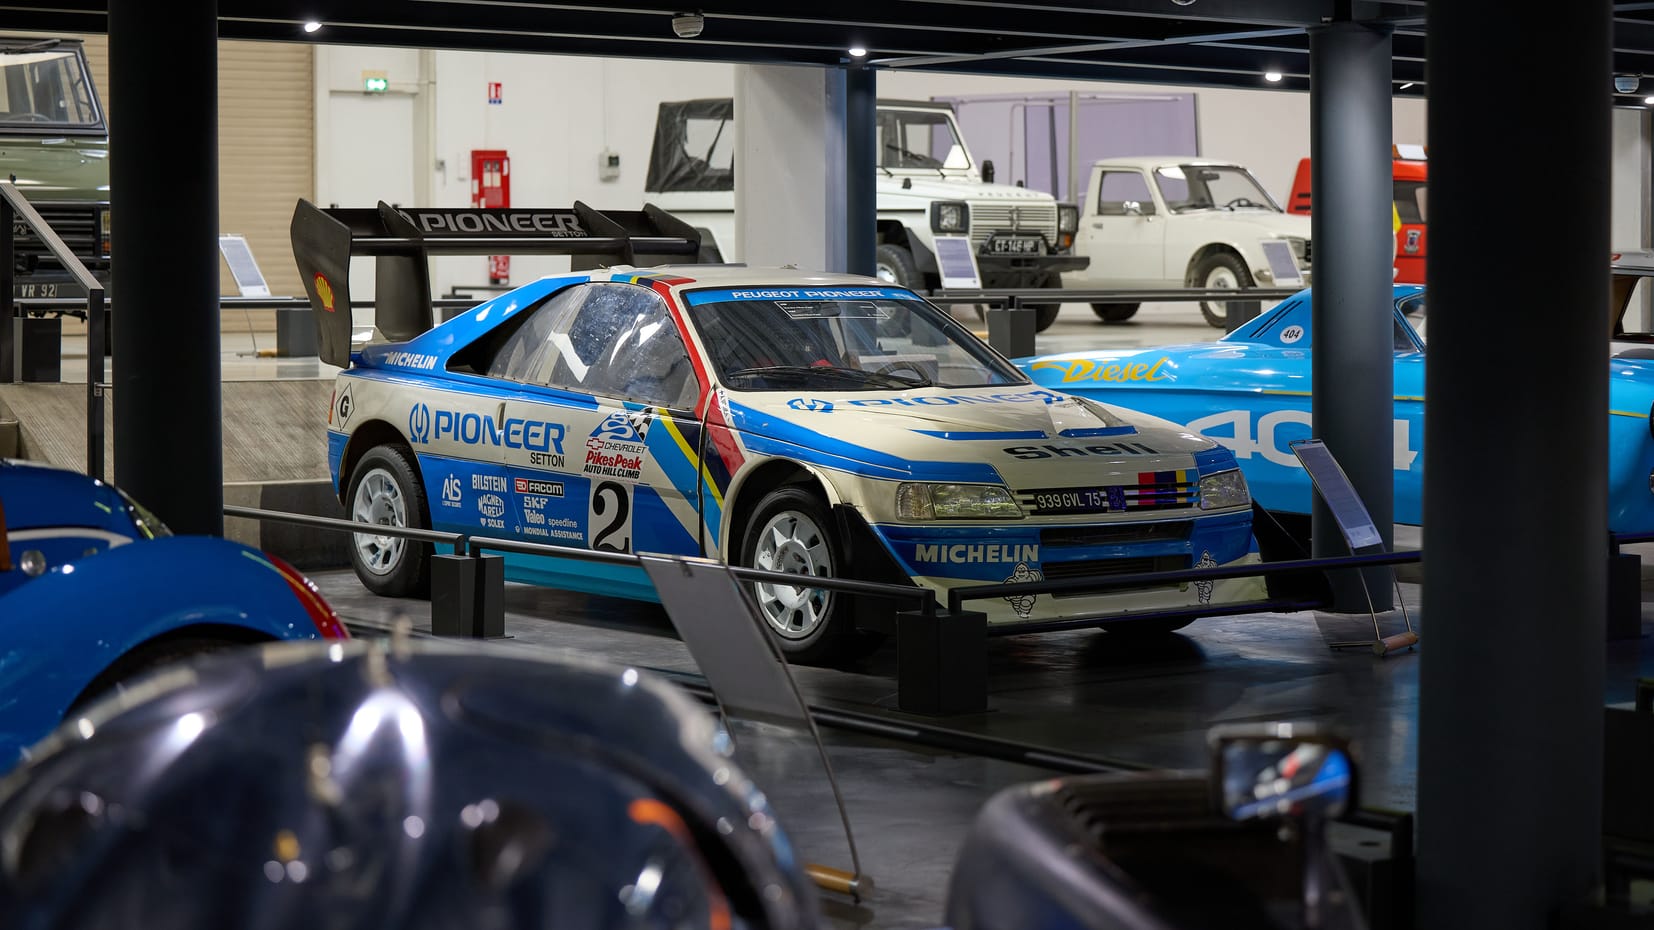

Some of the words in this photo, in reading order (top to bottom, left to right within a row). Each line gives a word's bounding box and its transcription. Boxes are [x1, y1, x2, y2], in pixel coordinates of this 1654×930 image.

[419, 213, 585, 232] PIONEER
[41, 284, 55, 297] 92
[732, 290, 800, 299] PEUGEOT
[804, 290, 885, 298] PIONEER
[1283, 329, 1301, 340] 404
[384, 352, 438, 370] MICHELIN
[1032, 357, 1169, 383] Diesel
[340, 395, 350, 417] G
[434, 410, 565, 455] PIONEER
[604, 441, 647, 454] CHEVROLET
[1002, 443, 1159, 460] Shell
[530, 452, 565, 468] SETTON
[585, 450, 614, 467] Pikes
[614, 454, 642, 470] Peak
[583, 464, 602, 475] AUTO
[602, 467, 617, 477] HILL
[617, 469, 640, 480] CLIMB
[472, 474, 507, 493] BILSTEIN
[529, 482, 562, 495] FACOM
[523, 496, 549, 510] SKF
[1037, 494, 1062, 509] 939
[1062, 492, 1085, 507] GVL
[1085, 492, 1101, 506] 75
[487, 518, 505, 529] SOLEX
[523, 508, 545, 525] Valeo
[548, 517, 578, 528] speedline
[592, 480, 630, 554] 2
[550, 529, 584, 540] ASSISTANCE
[915, 544, 1040, 563] MICHELIN
